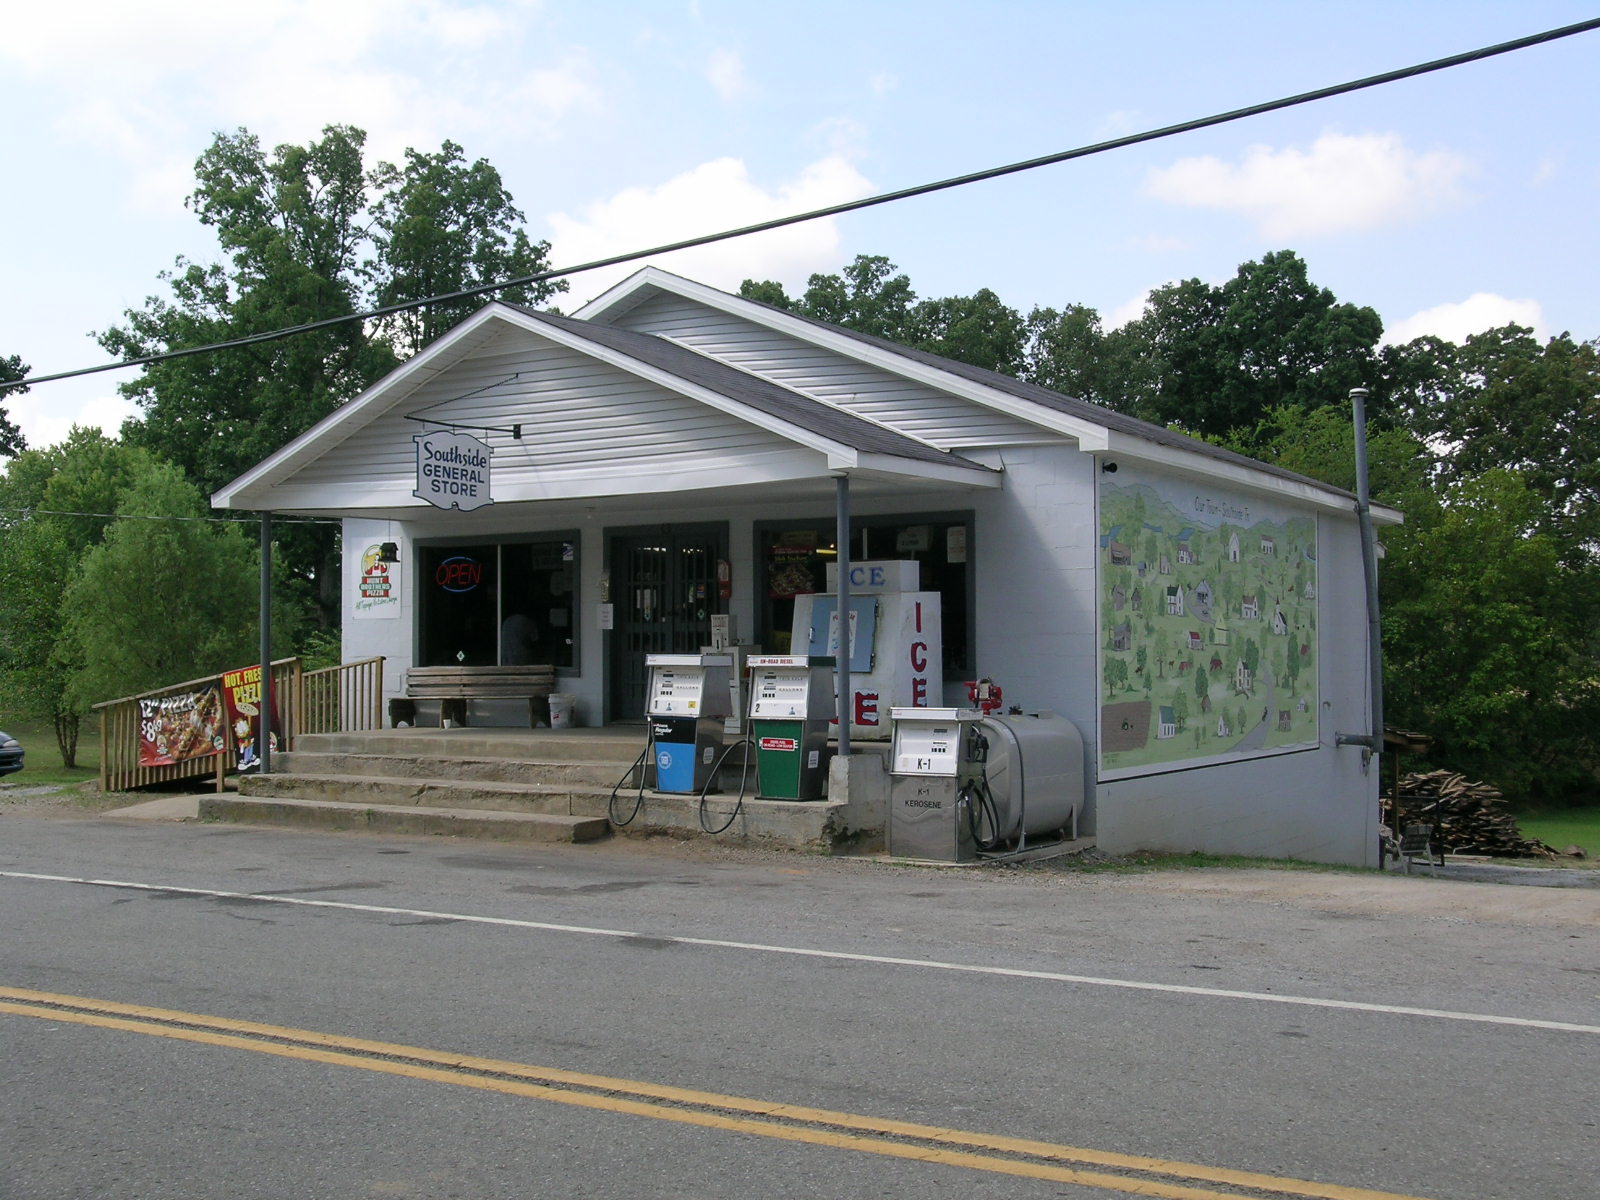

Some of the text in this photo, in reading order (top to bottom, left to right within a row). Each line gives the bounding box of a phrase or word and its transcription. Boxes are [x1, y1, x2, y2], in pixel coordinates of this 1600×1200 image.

[424, 441, 487, 468] Southside
[423, 463, 485, 484] GENERAL
[431, 479, 477, 497] STORE
[436, 563, 482, 585] OPEN
[850, 567, 886, 586] CE
[911, 602, 927, 707] ICE
[243, 667, 262, 684] FRES
[161, 692, 197, 715] PIZZA
[755, 703, 760, 713] 2
[917, 758, 931, 770] K-1
[918, 788, 930, 796] K-1
[905, 800, 942, 808] KEROSENE
